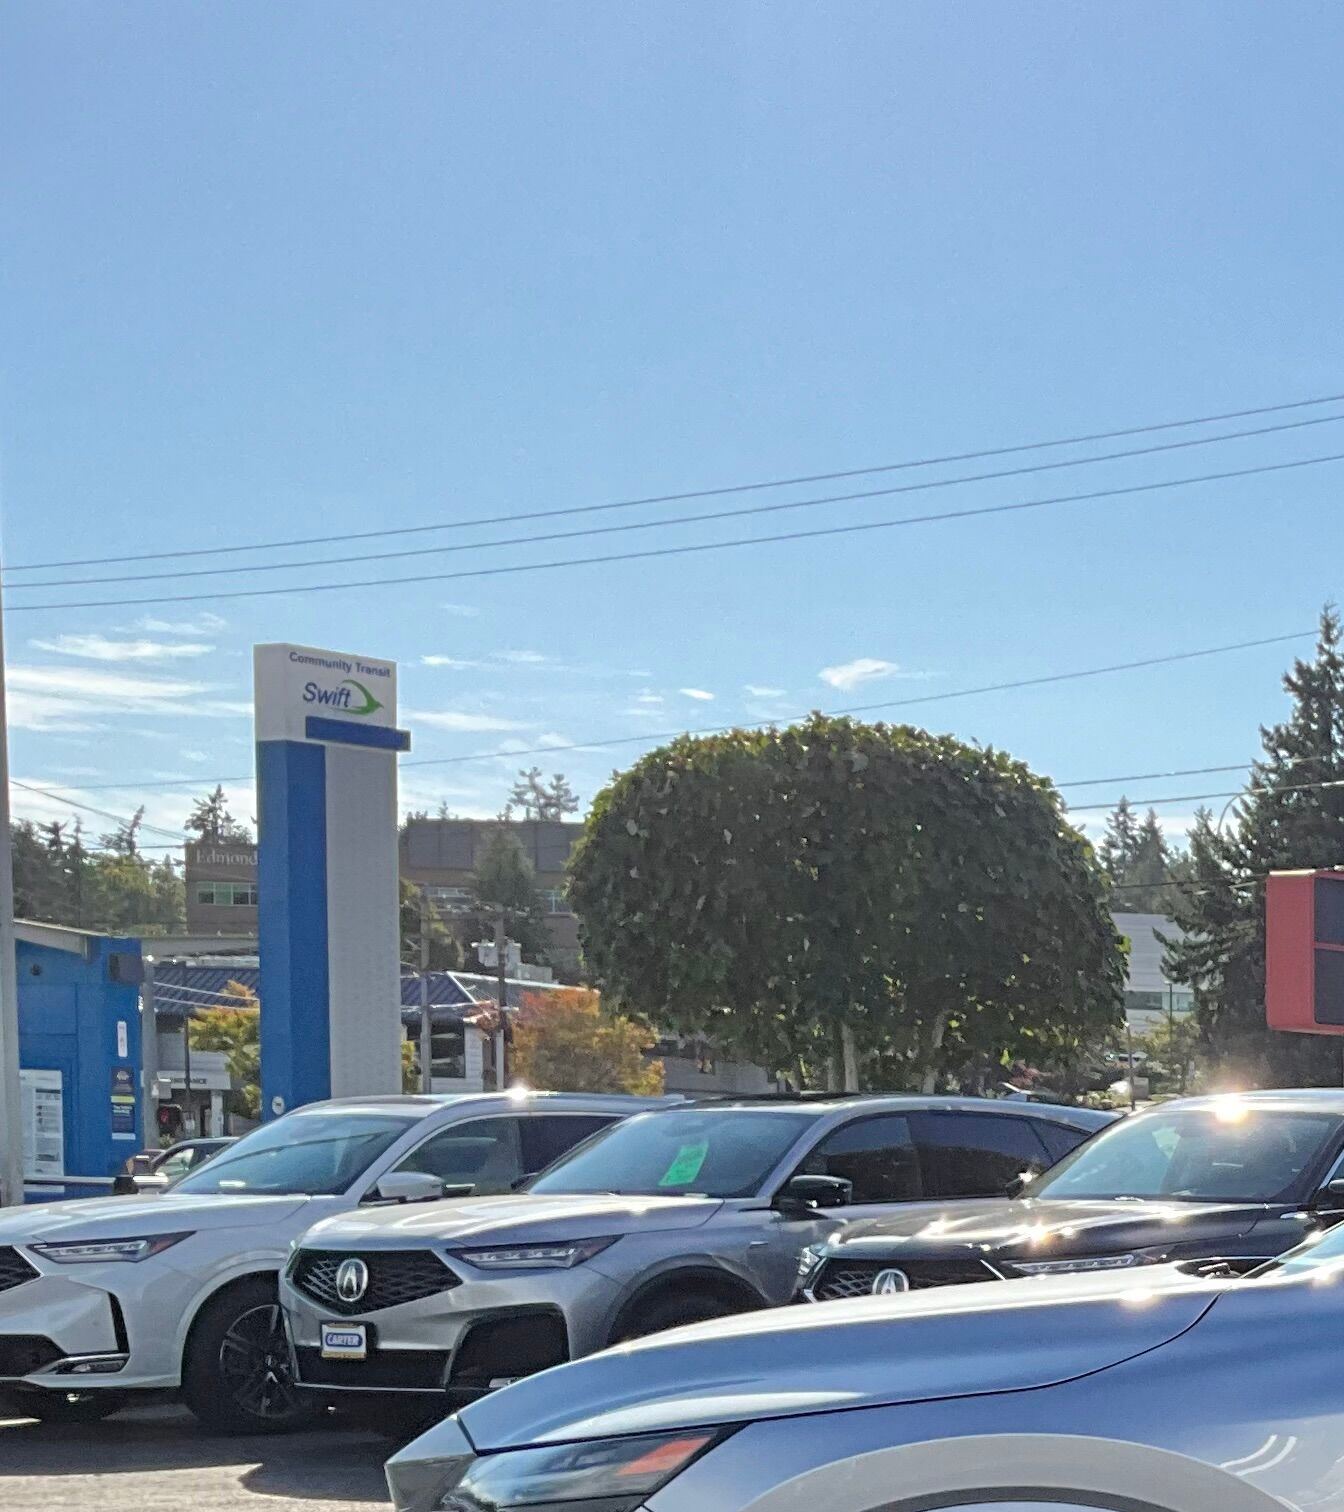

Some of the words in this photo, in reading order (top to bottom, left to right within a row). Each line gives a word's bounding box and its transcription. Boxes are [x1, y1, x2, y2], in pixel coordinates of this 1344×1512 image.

[289, 651, 352, 673] Community
[356, 662, 391, 678] Transit
[303, 682, 352, 708] Swift
